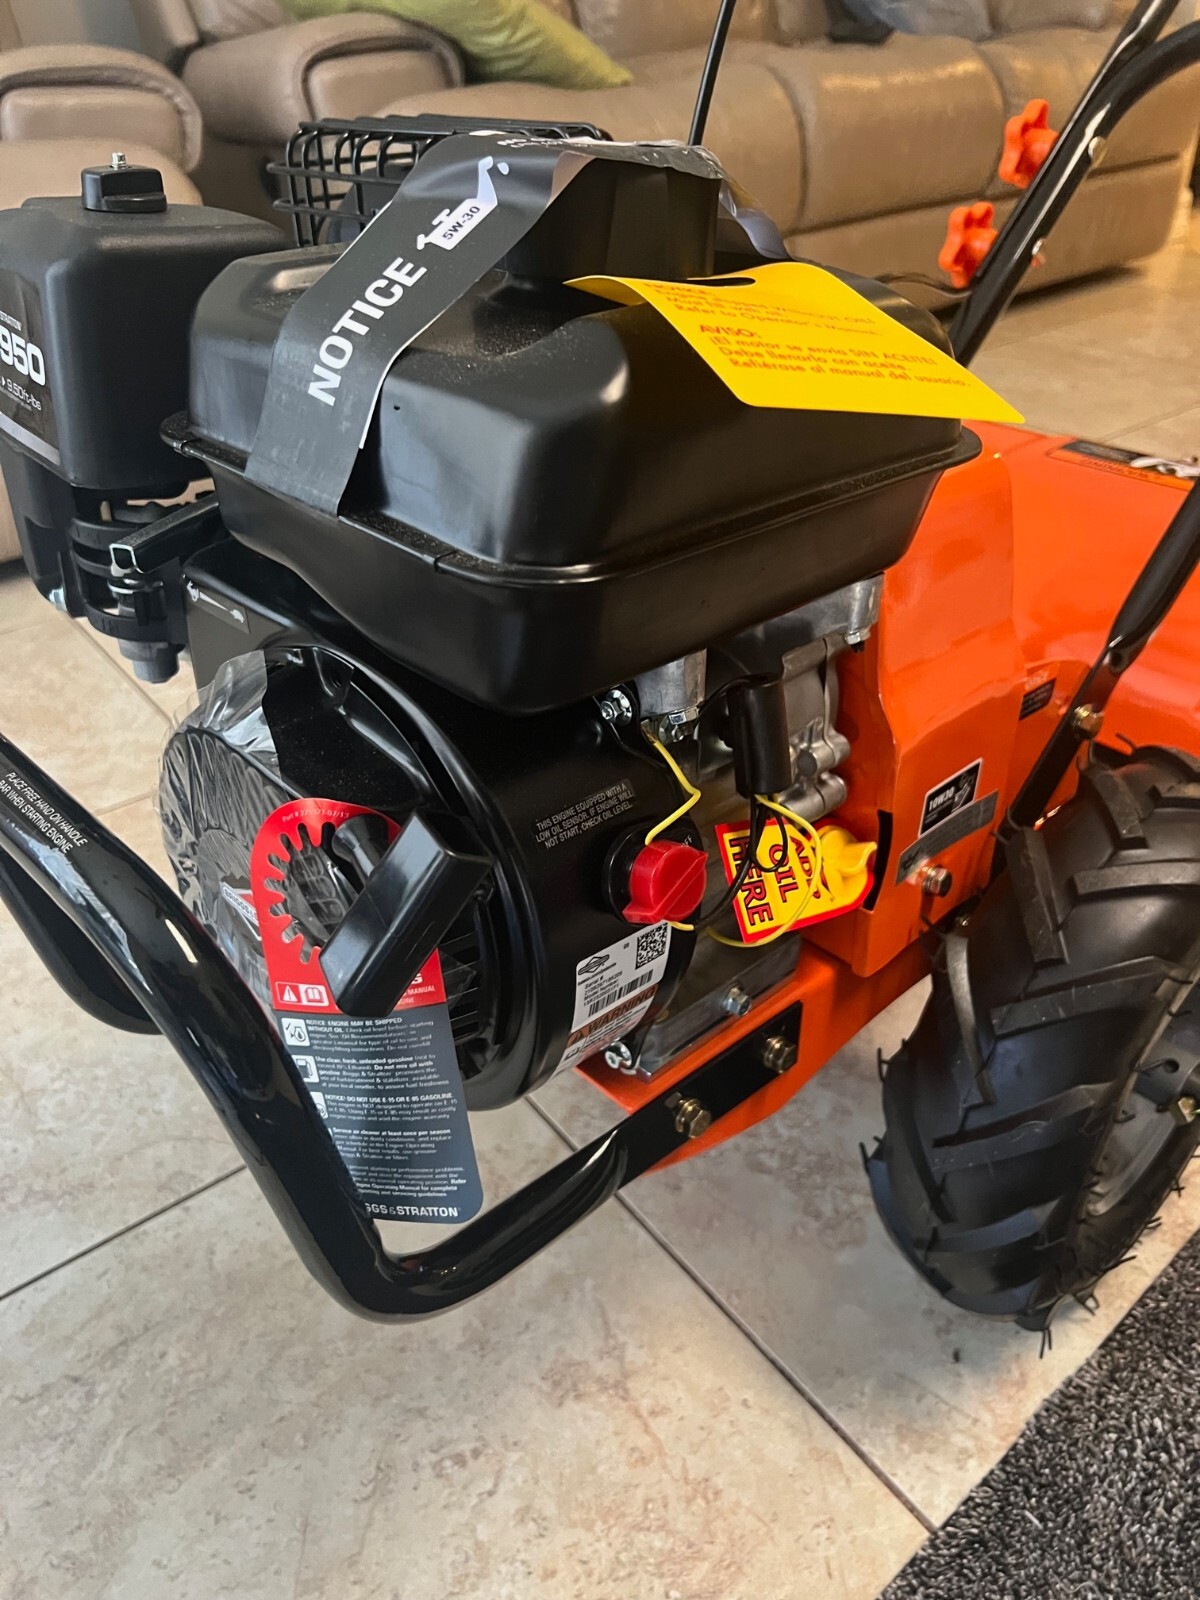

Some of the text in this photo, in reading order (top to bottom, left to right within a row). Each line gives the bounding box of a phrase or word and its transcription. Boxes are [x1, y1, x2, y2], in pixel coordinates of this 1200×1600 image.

[442, 205, 480, 241] 5W-30
[307, 257, 428, 407] NOTICE
[699, 324, 763, 340] AVISO:
[735, 339, 780, 349] motor
[785, 344, 803, 352] se
[718, 346, 764, 359] Debe
[765, 349, 827, 363] llenarlo
[831, 357, 859, 366] con
[810, 365, 826, 374] al
[829, 367, 885, 378] manual
[888, 369, 912, 381] del
[0, 780, 73, 853] BAR WHEN STARTING ENGINE
[6, 772, 88, 847] PLACE FREE HAND ON HANDLE
[535, 790, 633, 843] LOW OIL SENSOR. IF ENGINE WILL
[536, 783, 628, 831] THIS ENGINE EQUIPPED WITH A
[545, 837, 560, 850] NOT
[560, 825, 583, 843] START,
[581, 815, 603, 831] CHECK
[602, 808, 614, 820] OIL
[728, 836, 774, 927] HERE
[768, 843, 800, 903] OIL
[408, 984, 436, 996] MANUAL
[588, 985, 656, 1033] WARNING
[375, 1018, 402, 1026] SHIPPED
[396, 1206, 459, 1217] STRATTON
